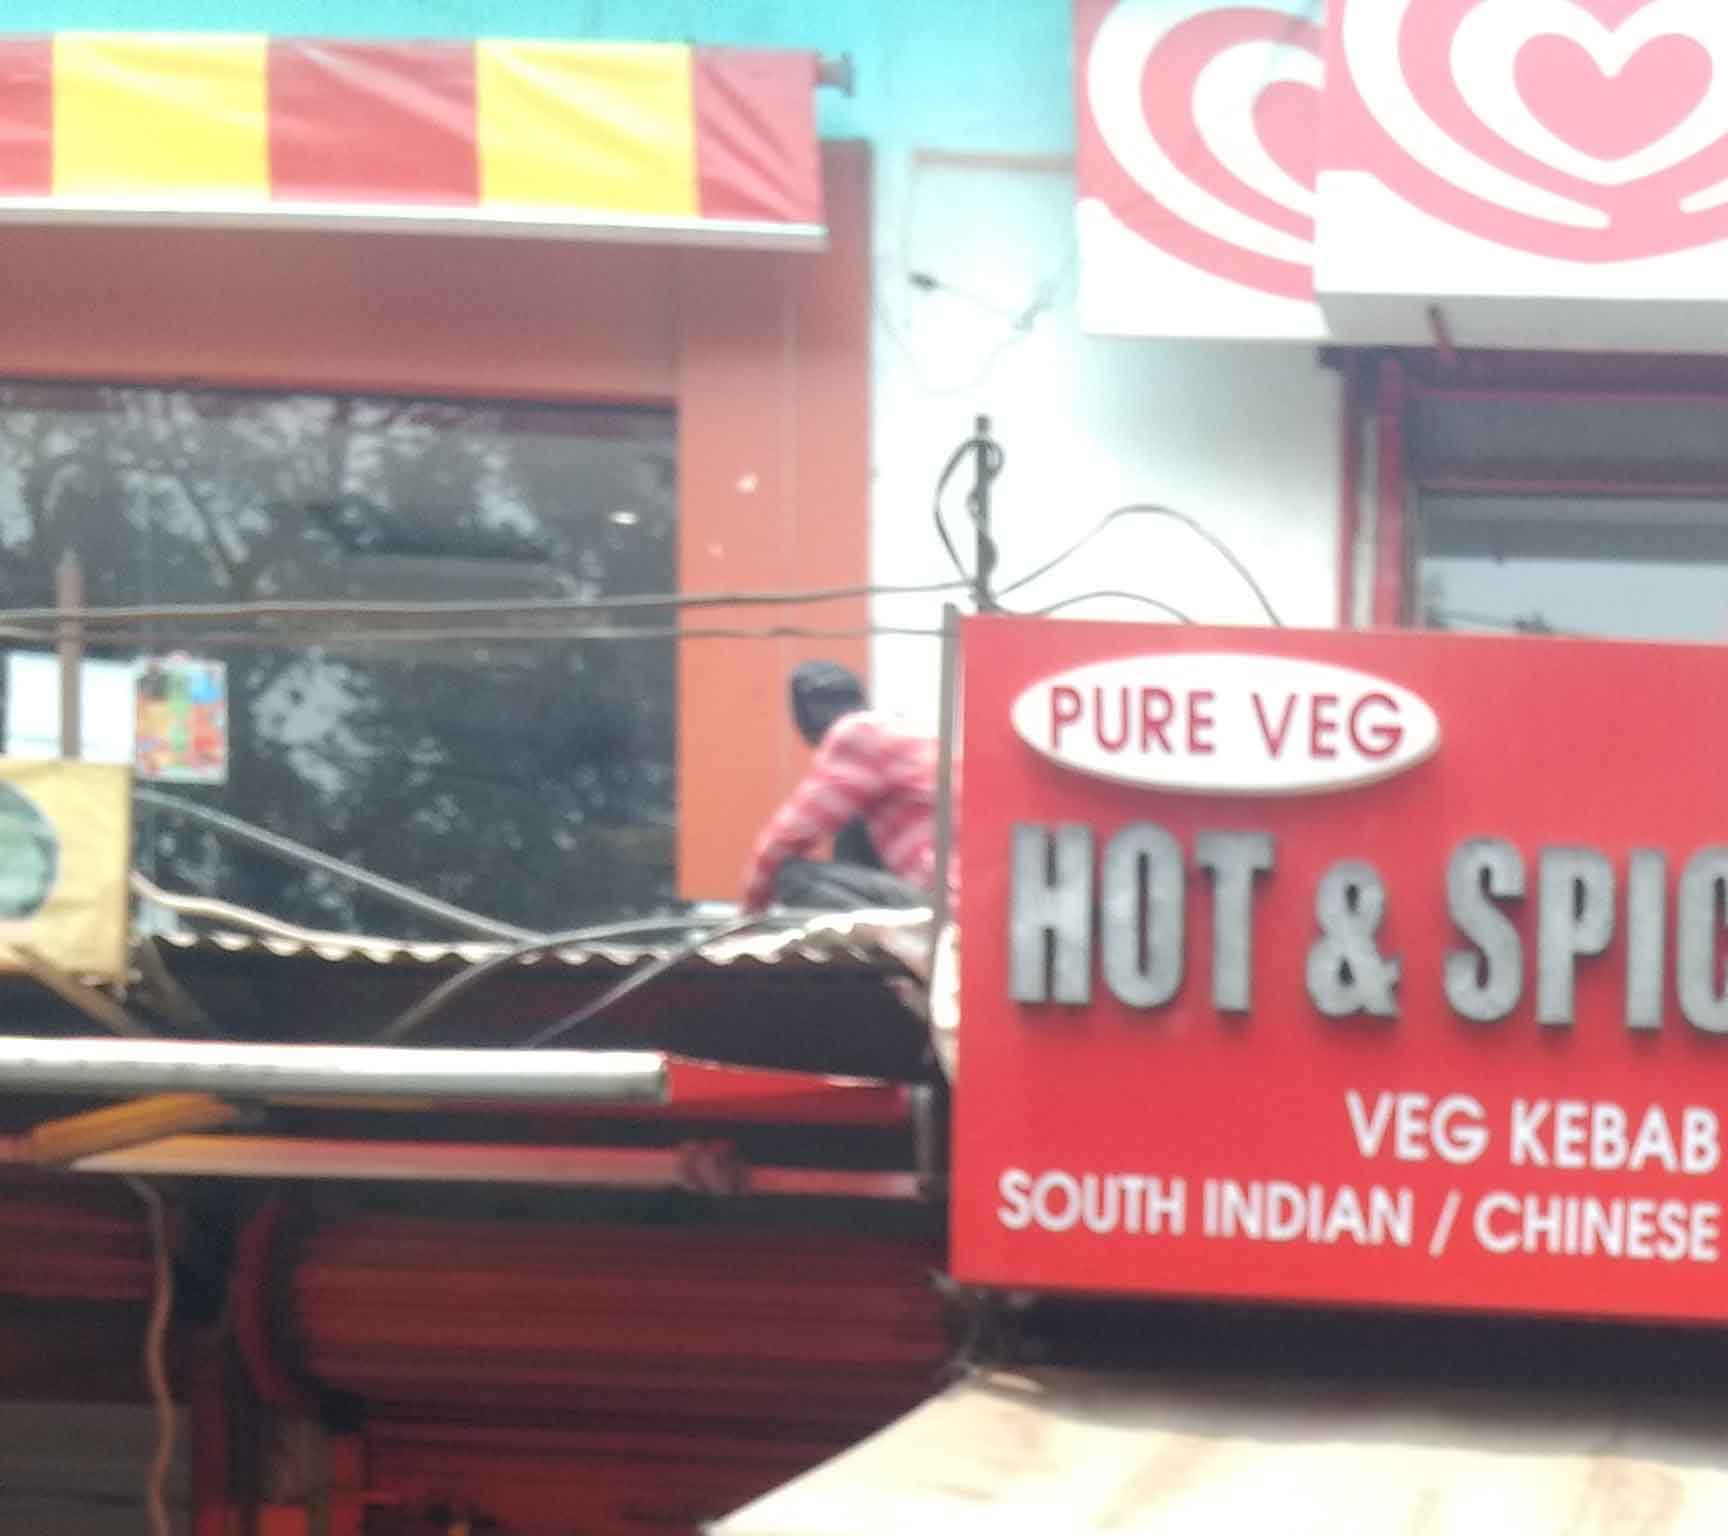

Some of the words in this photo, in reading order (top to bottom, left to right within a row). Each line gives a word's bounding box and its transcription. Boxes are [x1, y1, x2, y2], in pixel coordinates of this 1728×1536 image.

[1049, 686, 1215, 753] PURE
[1252, 692, 1406, 760] VEG
[1010, 822, 1276, 1012] HOT
[1305, 859, 1402, 1019] &
[1345, 1091, 1489, 1164] VEG
[1511, 1100, 1720, 1174] KEBAB
[998, 1167, 1185, 1236] SOUTH
[1203, 1178, 1412, 1246] INDIAN
[1473, 1192, 1721, 1263] CHINESE
